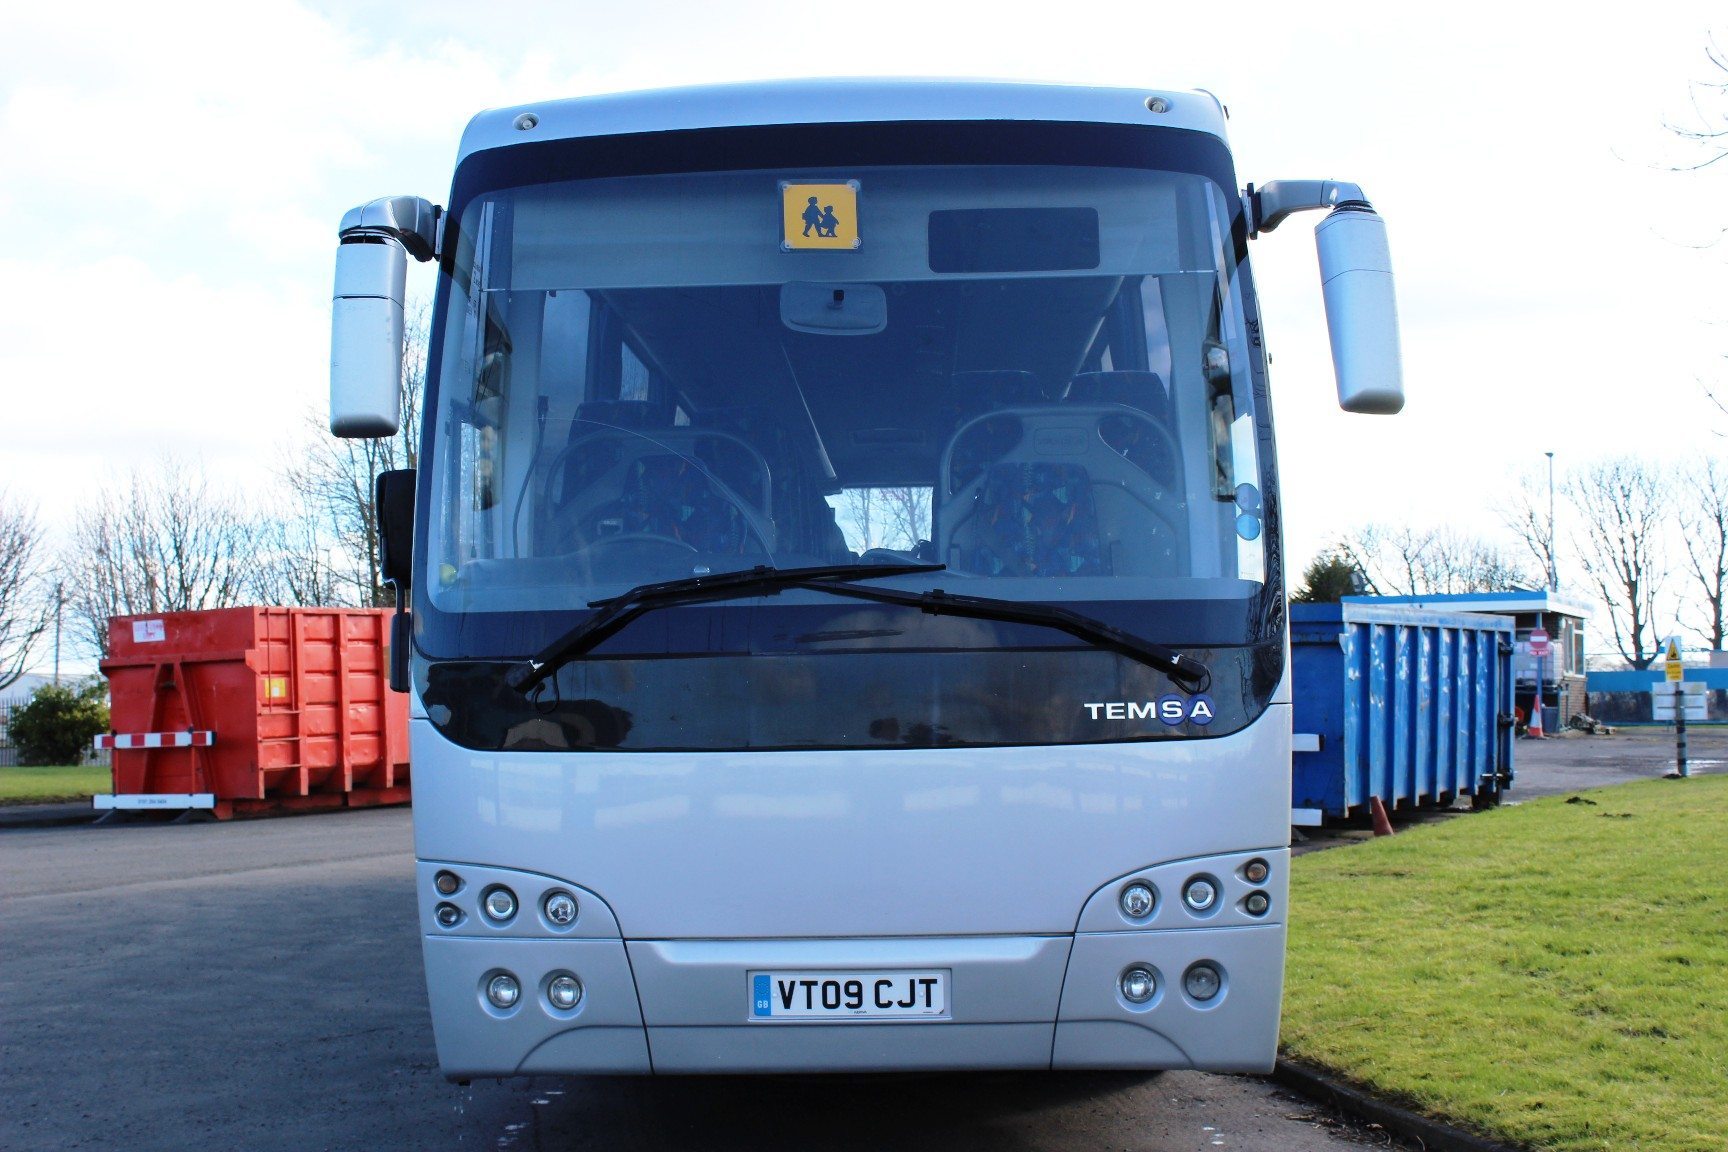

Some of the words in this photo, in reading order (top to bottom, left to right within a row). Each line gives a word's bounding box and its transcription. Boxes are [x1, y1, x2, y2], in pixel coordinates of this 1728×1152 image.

[1083, 701, 1213, 720] TEMSA
[777, 980, 863, 1010] VT09
[874, 978, 938, 1009] CJT
[757, 1000, 769, 1009] GB
